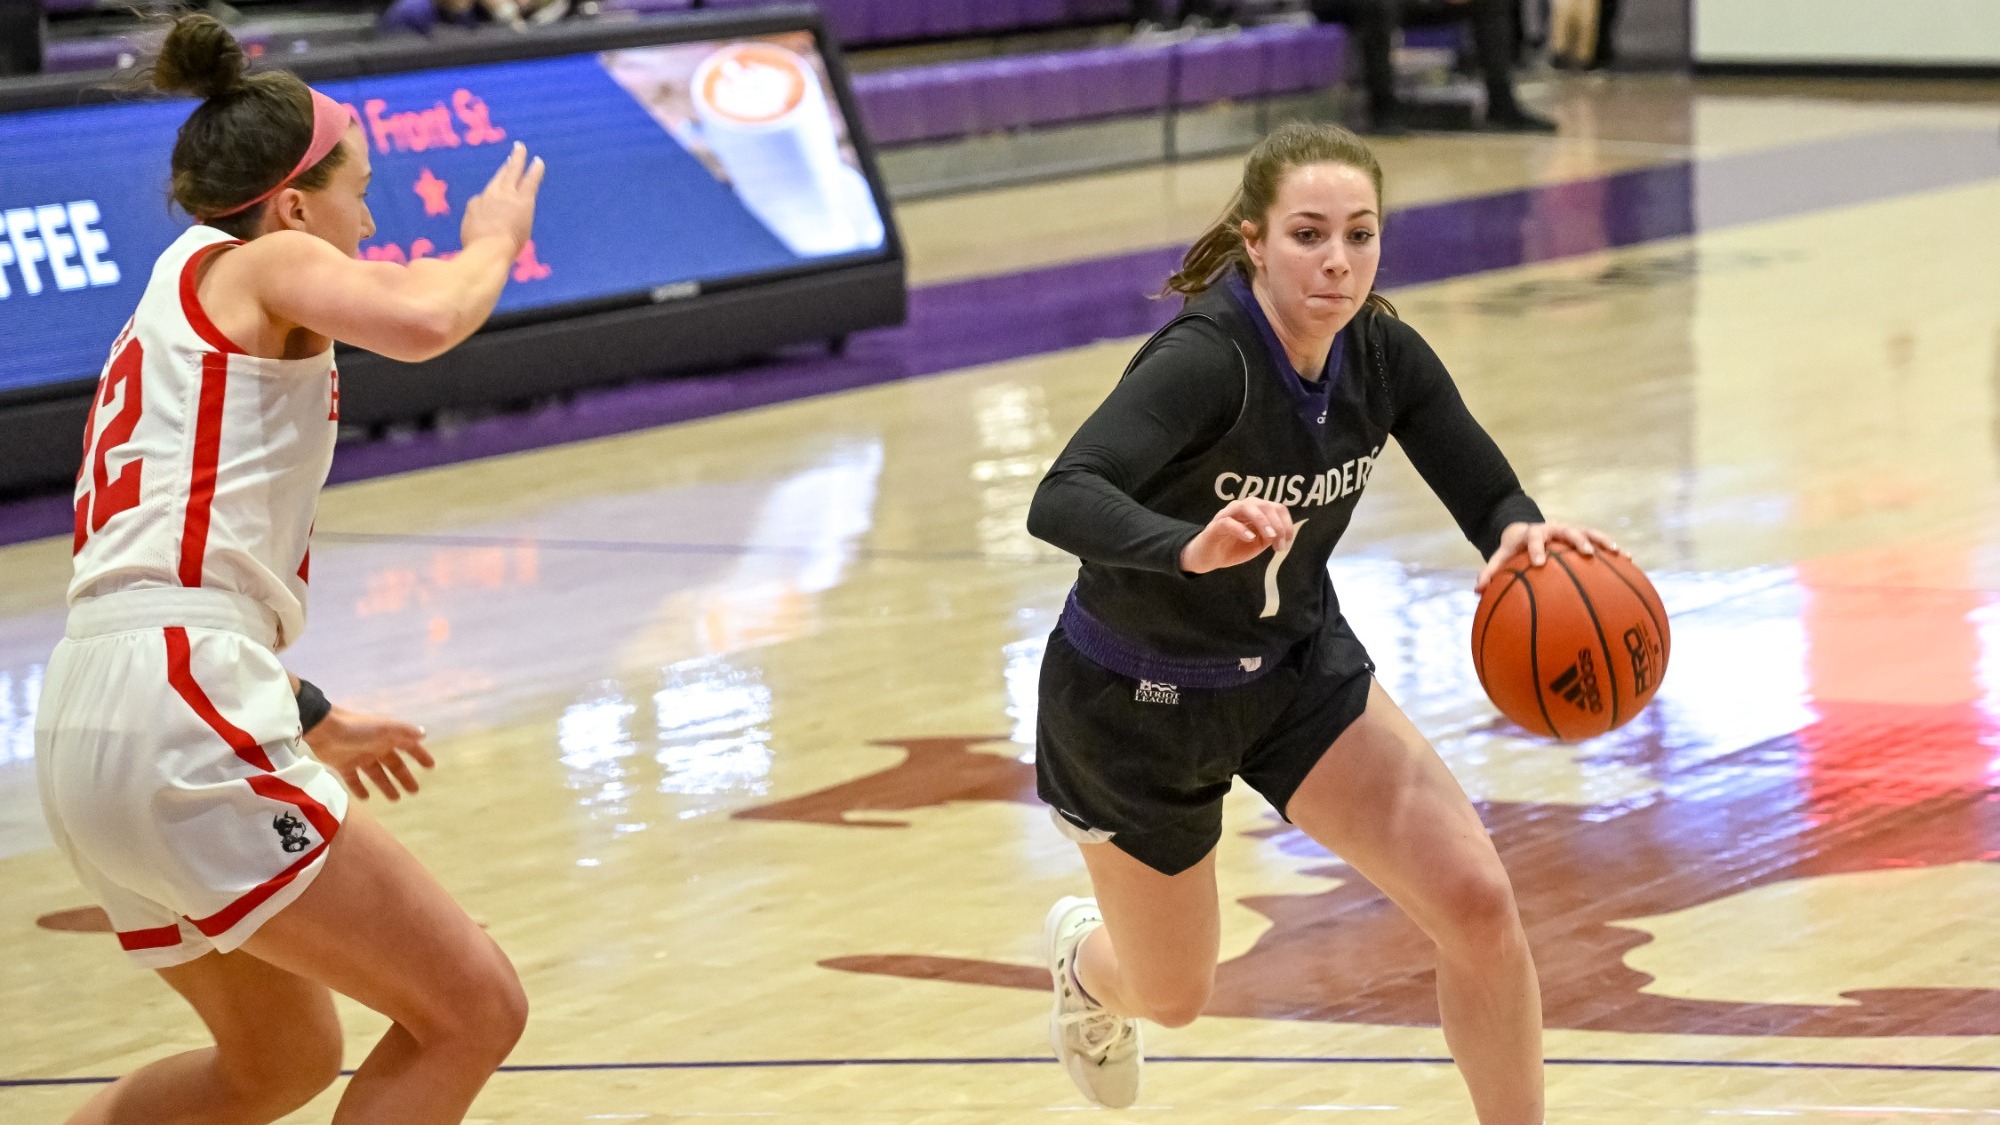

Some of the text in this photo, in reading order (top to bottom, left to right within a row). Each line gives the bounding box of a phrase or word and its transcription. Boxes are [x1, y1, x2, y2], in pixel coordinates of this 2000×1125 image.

[1135, 689, 1181, 700] PATRIOT
[1577, 647, 1604, 714] adidas
[1623, 626, 1649, 698] PRO
